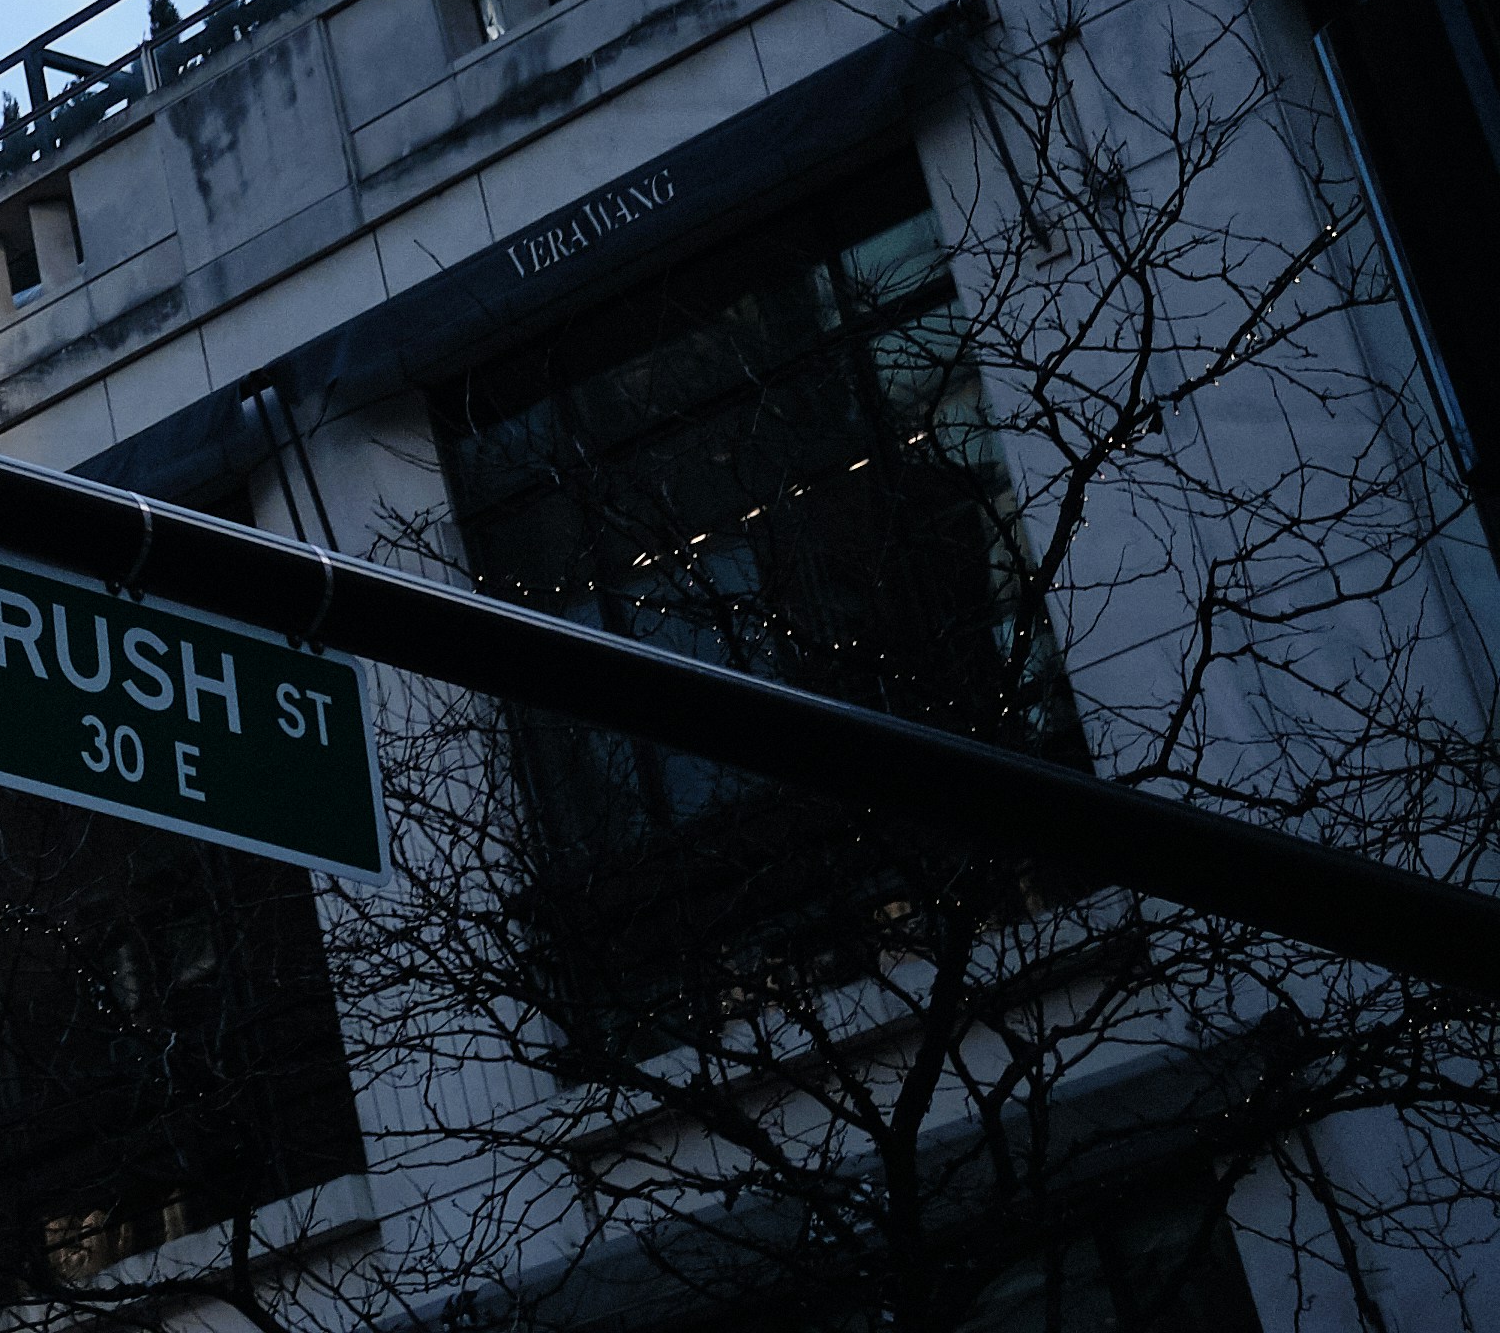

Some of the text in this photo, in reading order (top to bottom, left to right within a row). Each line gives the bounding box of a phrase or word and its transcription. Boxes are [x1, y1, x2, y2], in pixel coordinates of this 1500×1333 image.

[507, 169, 675, 279] VERA WANG
[81, 714, 206, 802] 30 E
[277, 682, 332, 746] ST
